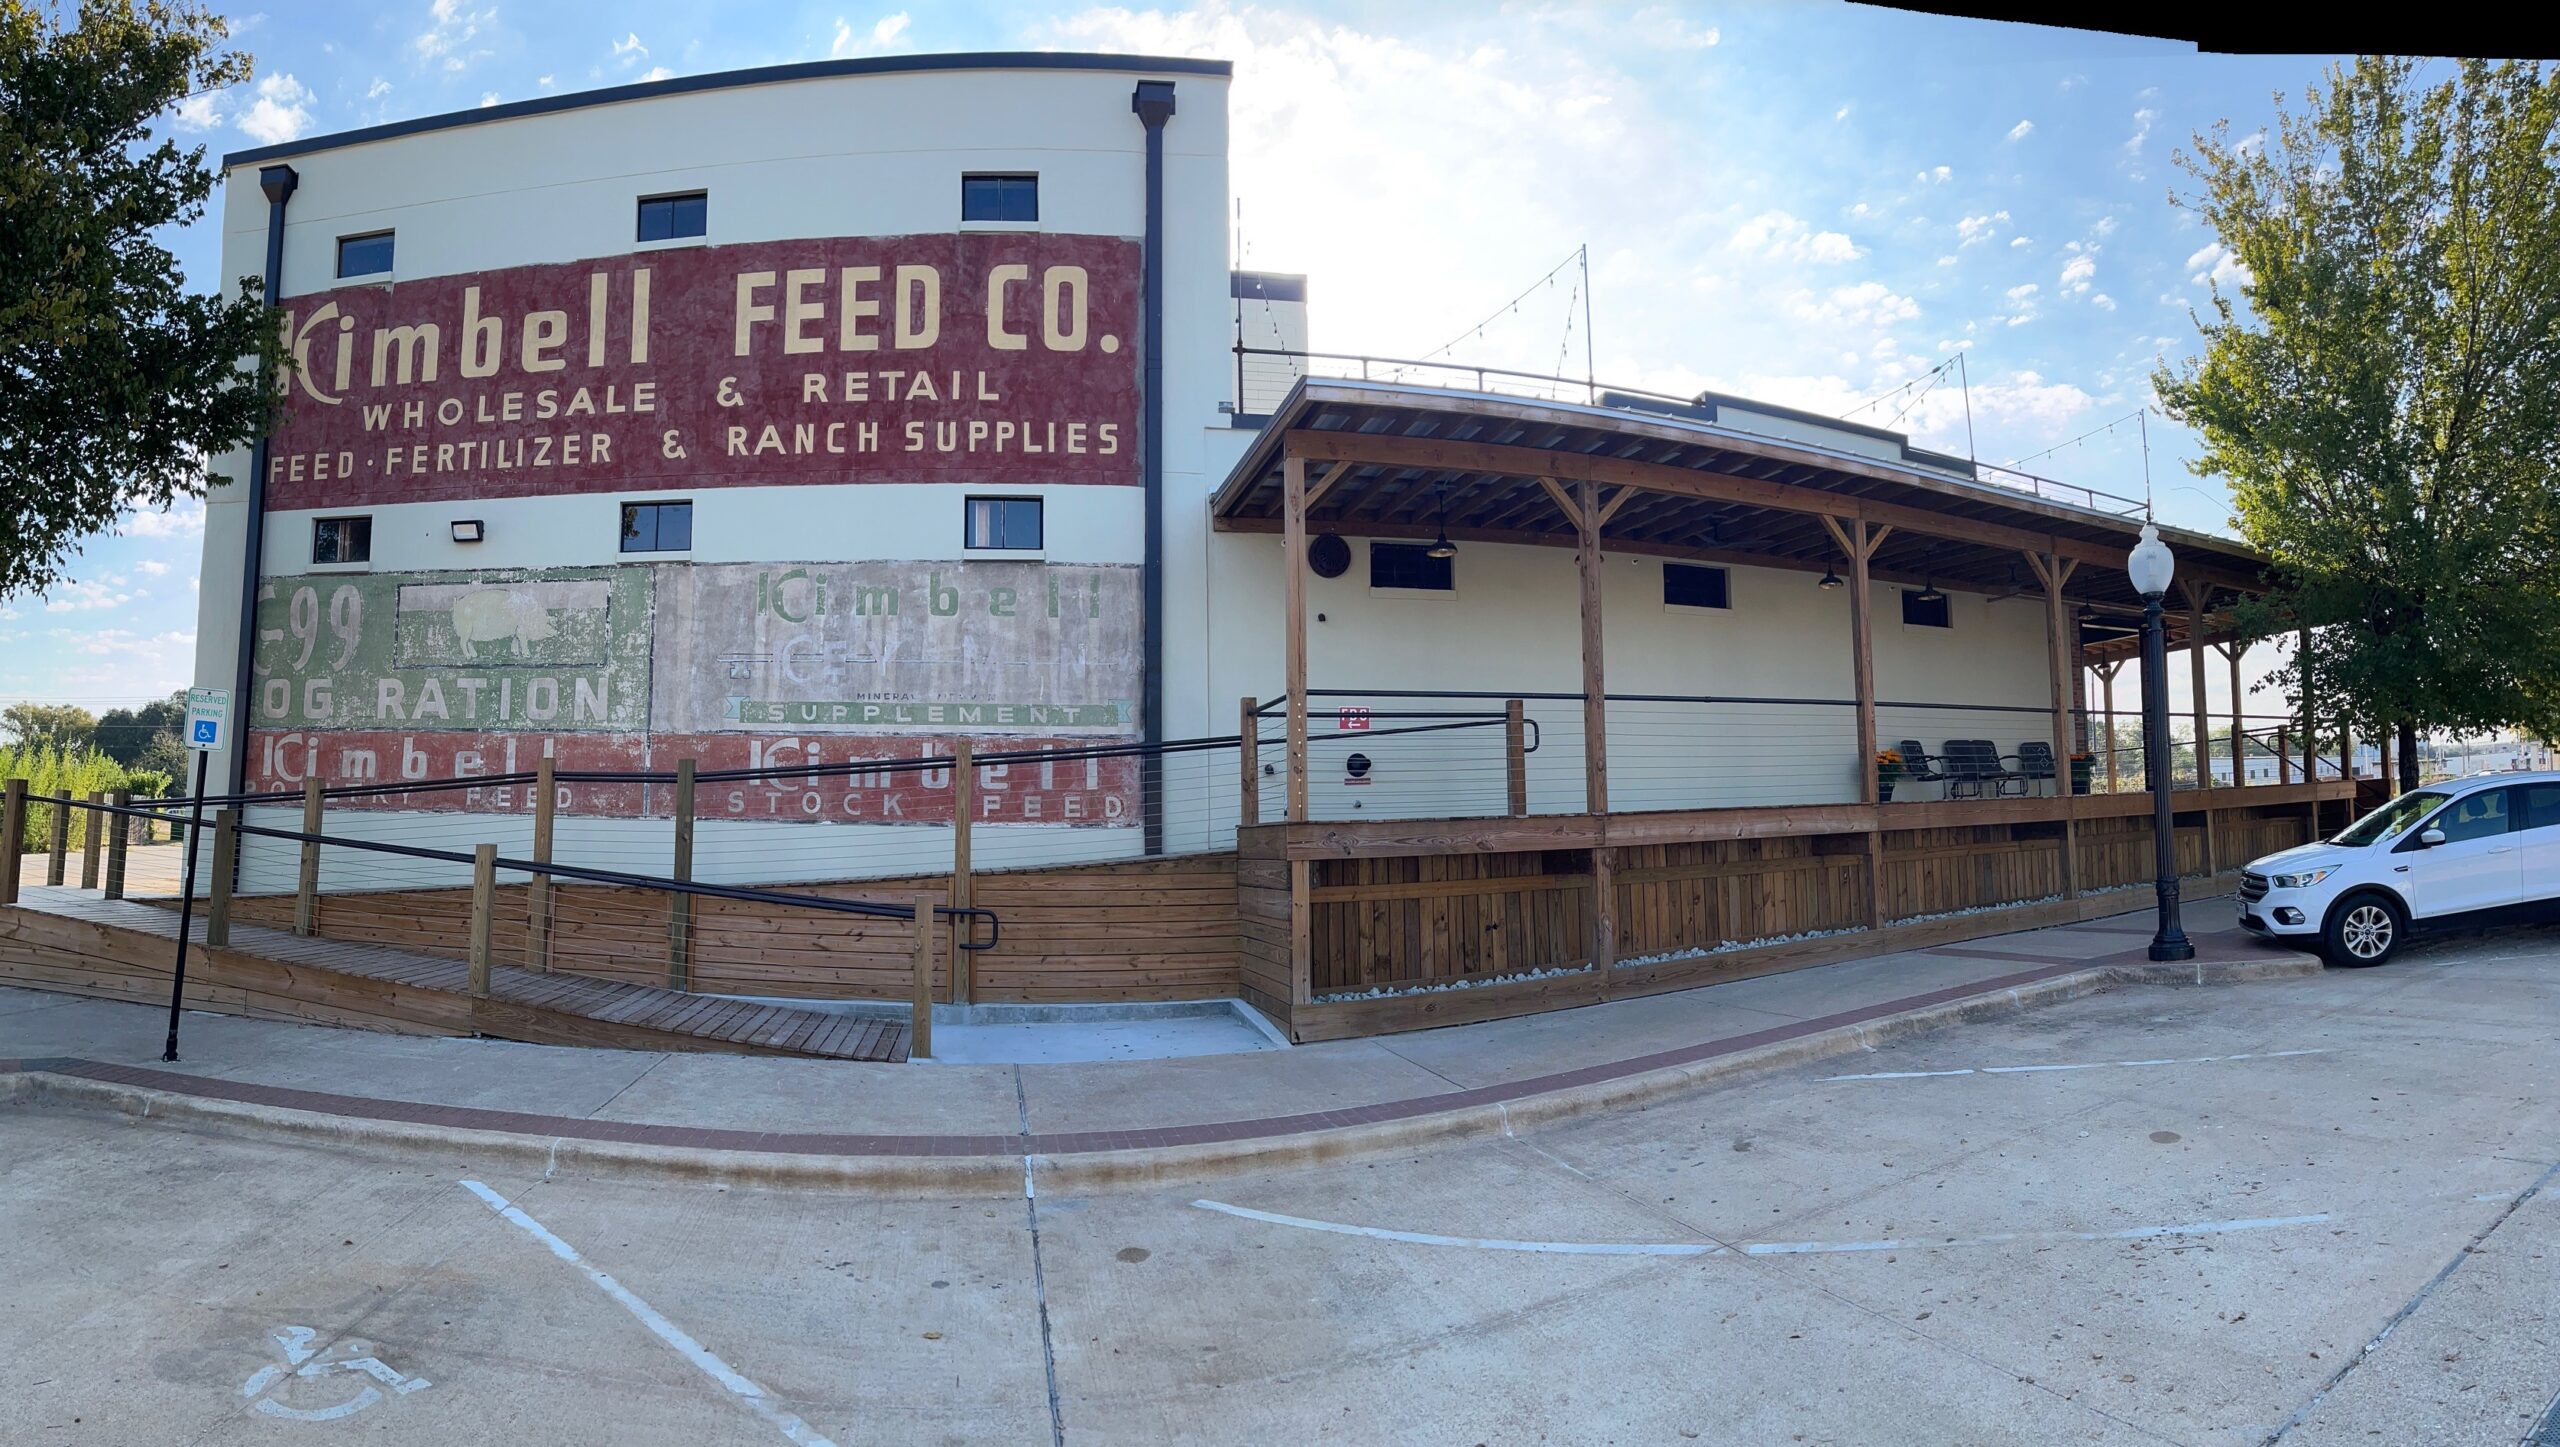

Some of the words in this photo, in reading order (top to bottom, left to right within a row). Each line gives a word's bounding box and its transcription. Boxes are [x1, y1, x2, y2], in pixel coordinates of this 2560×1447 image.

[276, 269, 651, 405] Kimbell
[735, 264, 940, 356] FEED
[988, 264, 1119, 353] CO.
[362, 382, 656, 432] WHOLESALE
[716, 376, 744, 407] &
[804, 370, 999, 403] RETAIL
[270, 451, 353, 484] FEED
[386, 433, 611, 476] FERTILIZER
[663, 430, 687, 459] &
[727, 423, 878, 456] RANCH
[905, 420, 1119, 454] SUPPLIES
[757, 568, 1101, 624] Kimbell
[190, 694, 227, 705] RESERVED
[191, 707, 223, 718] PARKING
[377, 677, 609, 721] RATION
[768, 704, 1082, 724] SUPPLEMENT
[262, 733, 555, 782] Kimbell
[749, 737, 1099, 792] Kimbell
[728, 792, 904, 816] STOCK
[983, 795, 1124, 818] FEED
